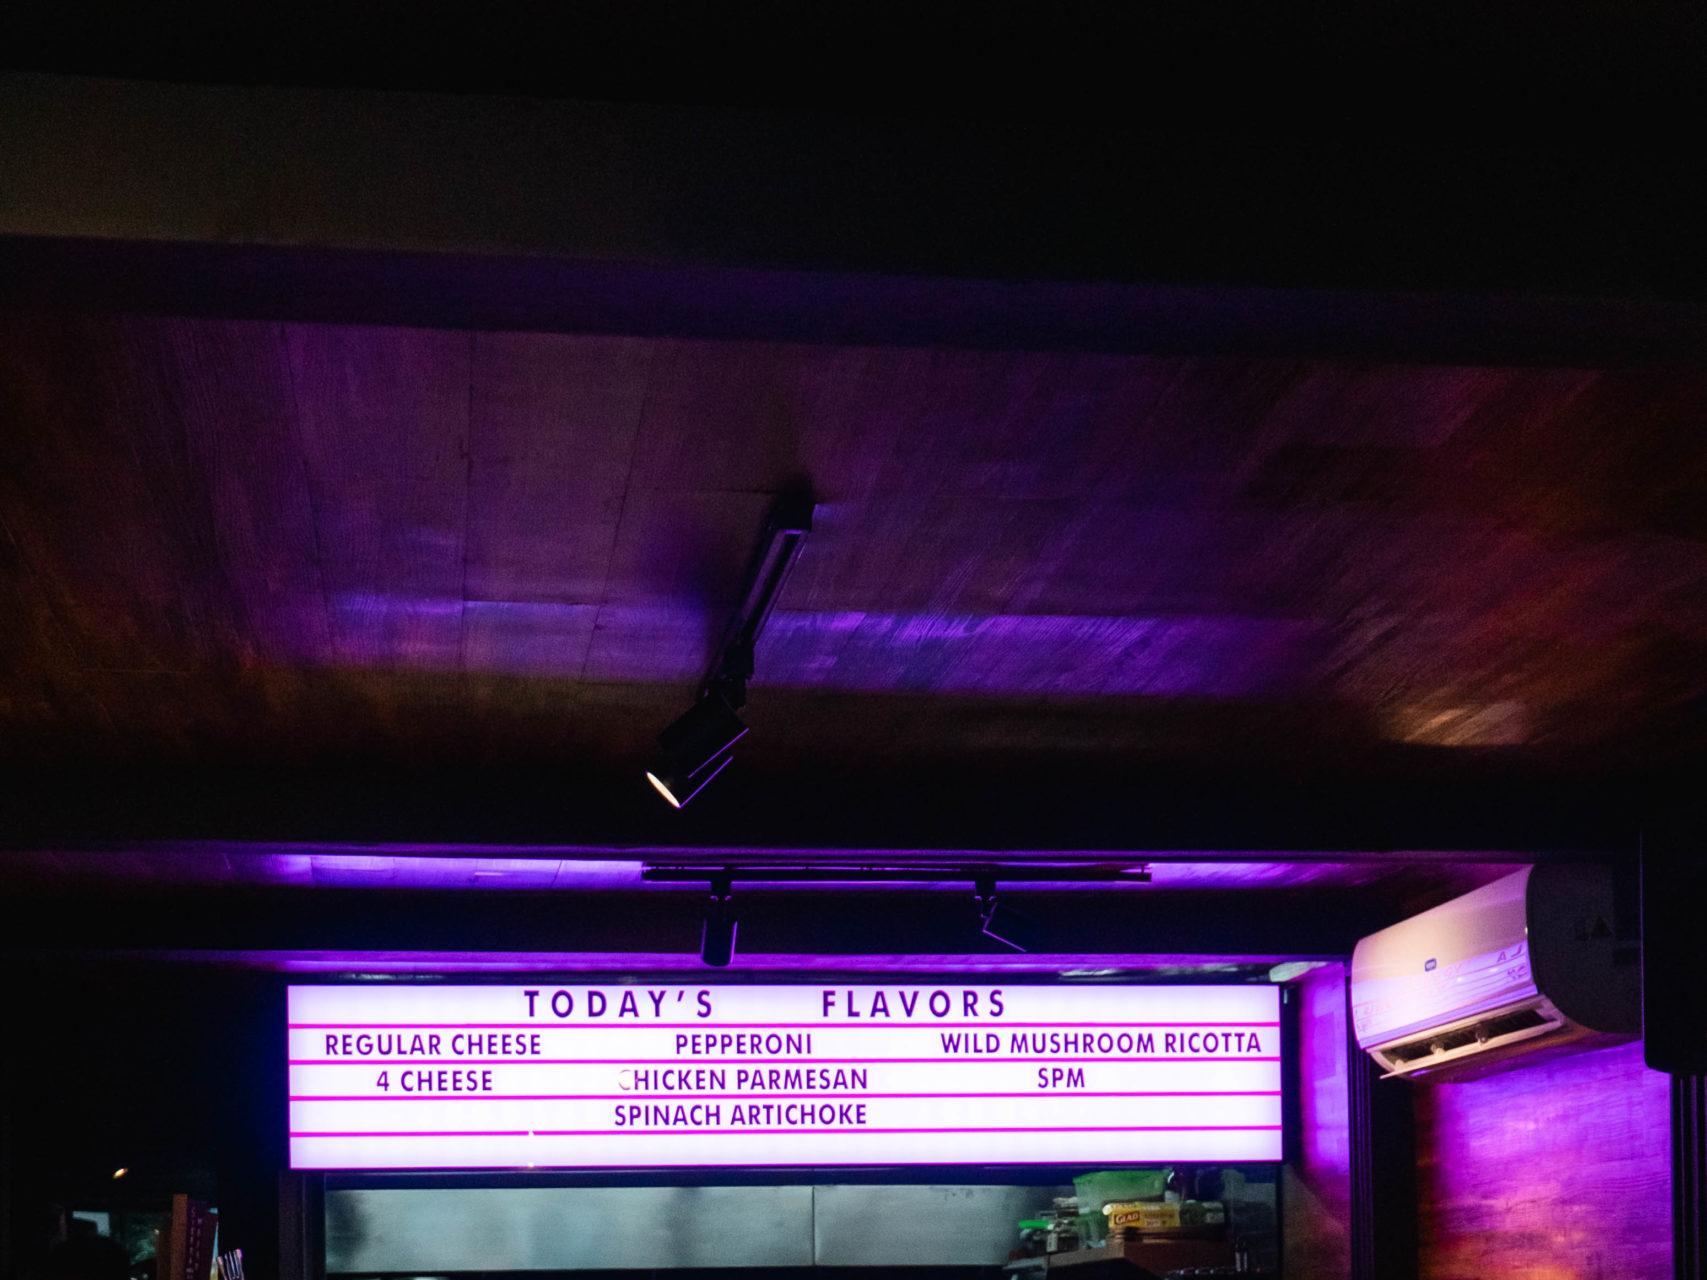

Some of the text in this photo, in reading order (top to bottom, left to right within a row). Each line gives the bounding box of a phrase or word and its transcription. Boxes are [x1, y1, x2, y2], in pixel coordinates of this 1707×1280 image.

[523, 988, 1005, 1019] TODAY'S FLAVORS
[325, 1033, 541, 1056] REGULAR CHEESE
[675, 1033, 812, 1055] PEPPERONI
[941, 1032, 1262, 1054] WILD MUSHROOM RICOTTA
[376, 1070, 493, 1092] 4 CHEESE
[618, 1068, 868, 1091] CHICKEN PARMESAN
[1037, 1067, 1085, 1089] SPM
[614, 1103, 867, 1127] SPINACH ARTICHOKE
